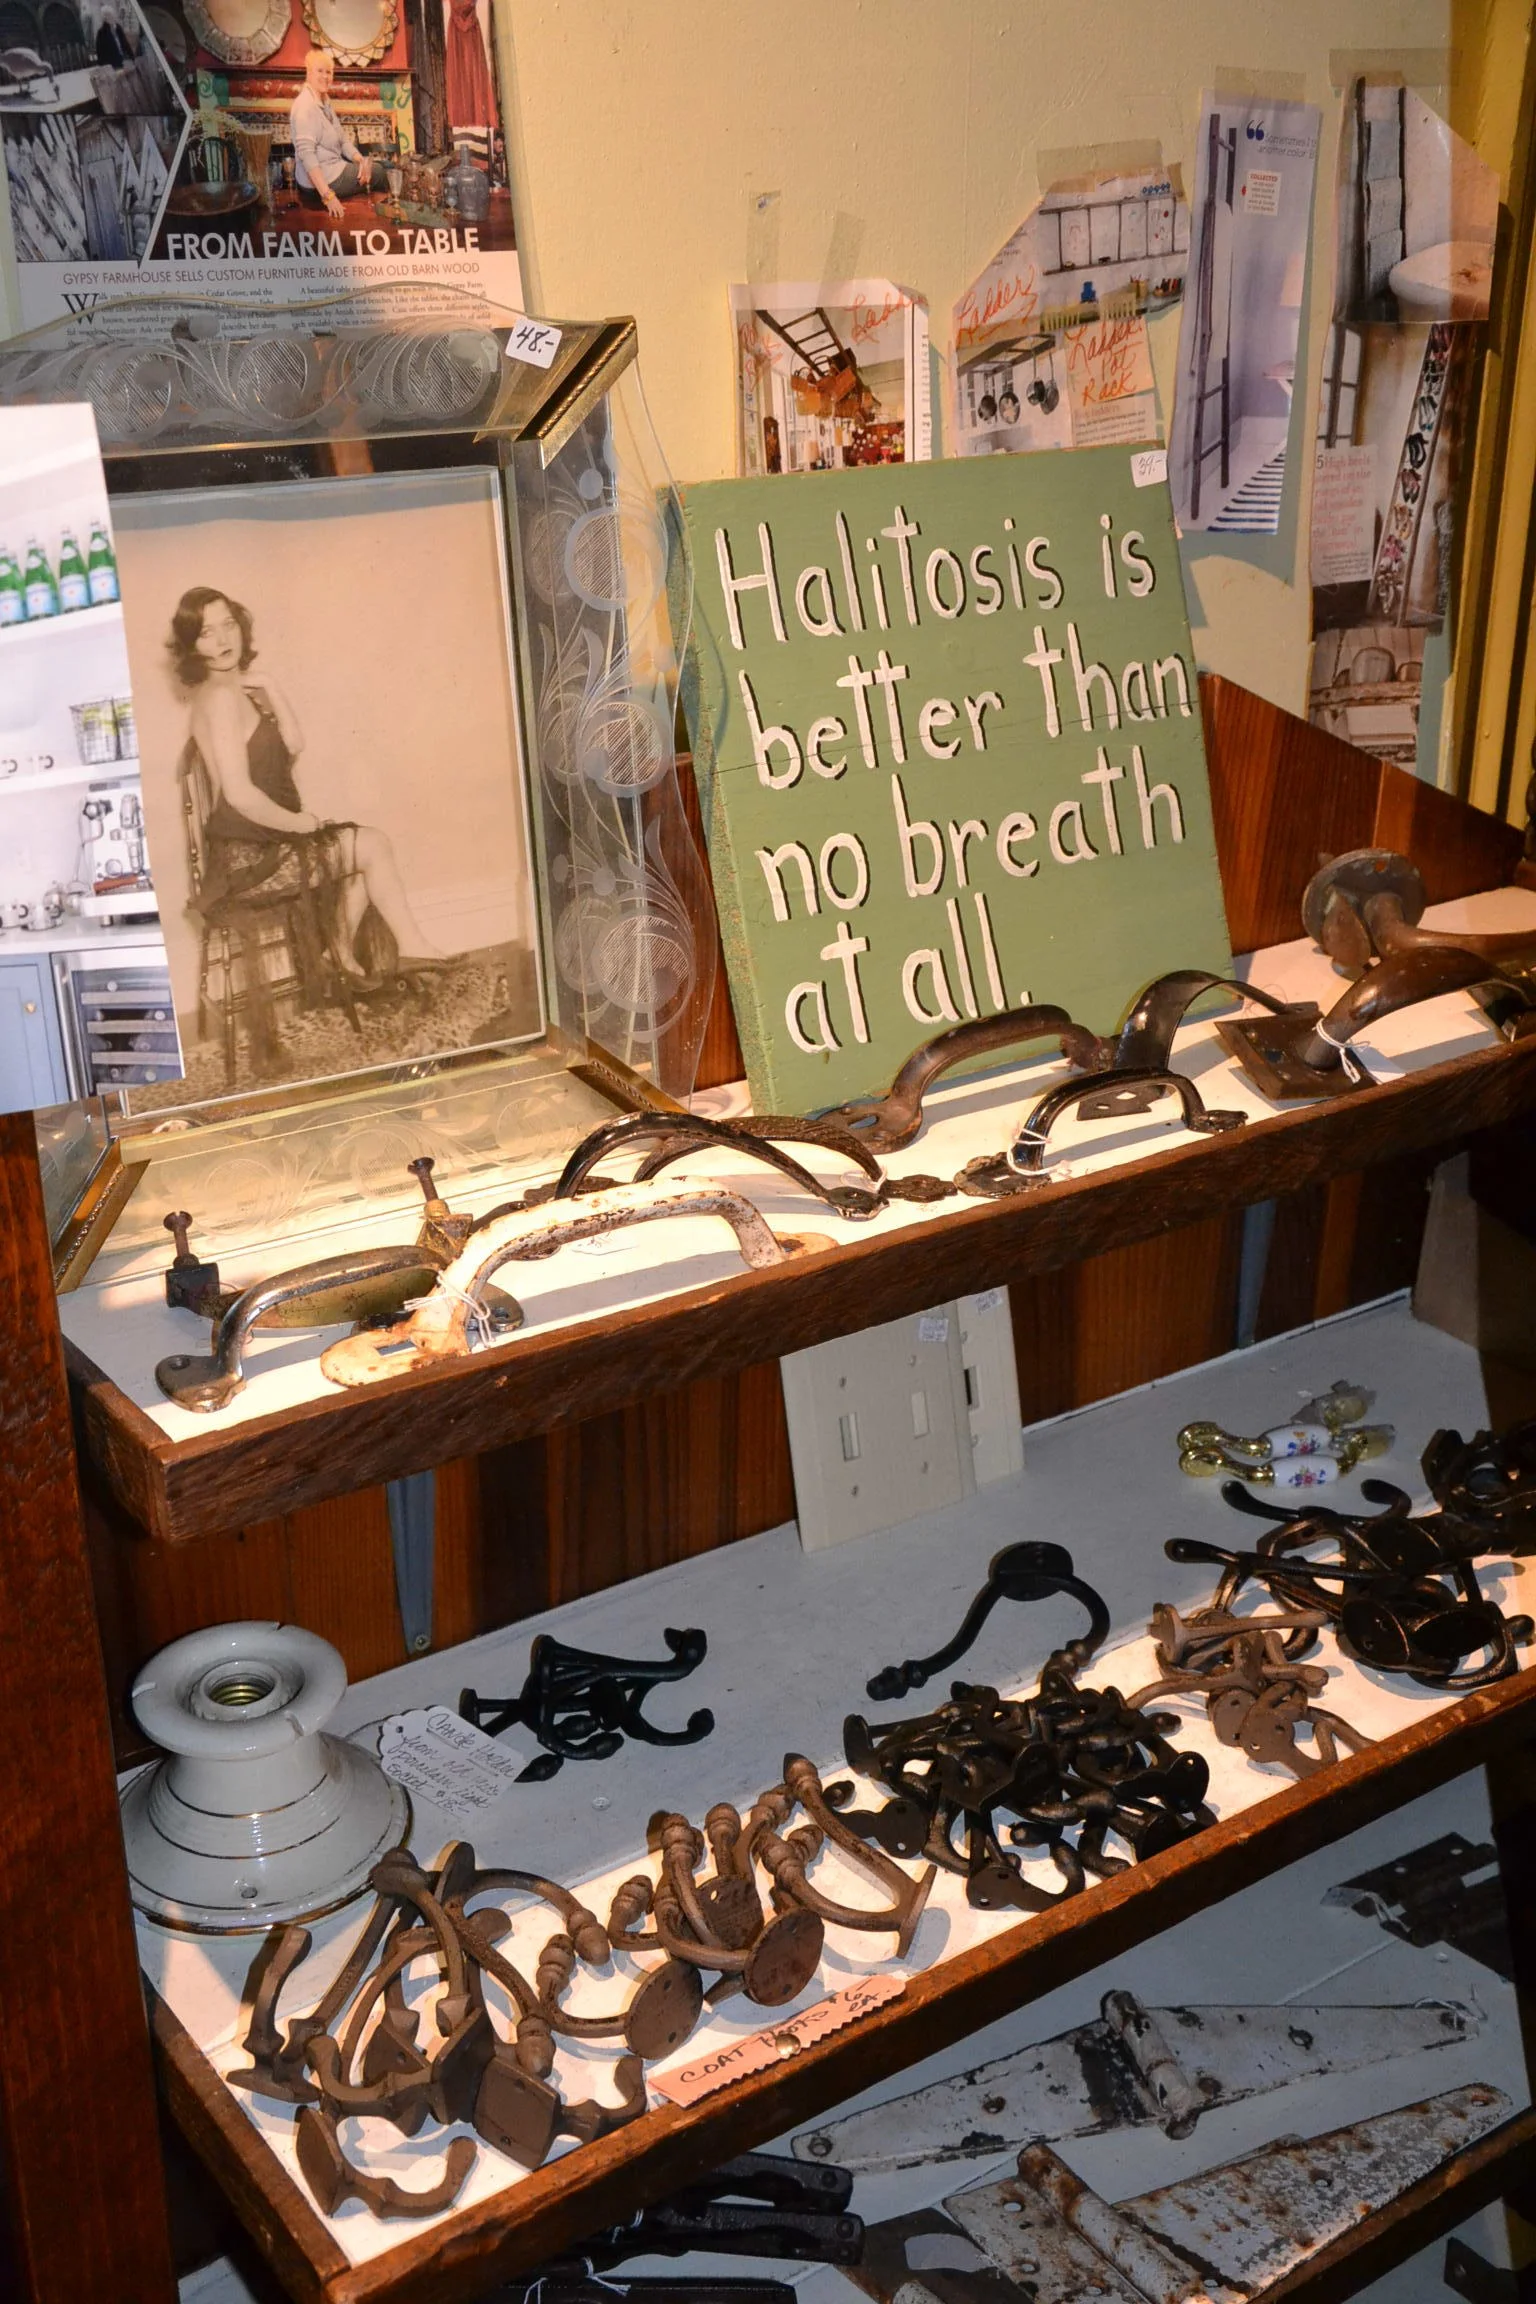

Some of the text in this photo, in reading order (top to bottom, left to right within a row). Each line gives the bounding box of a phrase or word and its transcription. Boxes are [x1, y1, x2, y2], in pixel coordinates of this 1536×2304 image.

[63, 262, 480, 285] GYPSY FARMHOUSE SELLS CUSTOM FURNITURE MADE FROM OLD BARN WOOD
[167, 227, 480, 261] FROM FARM TO TABLE
[715, 506, 1156, 650] Halitosis is
[738, 622, 1195, 790] better than
[755, 745, 1186, 922] no breath
[785, 892, 1034, 1054] at all.
[680, 2042, 748, 2084] COAT
